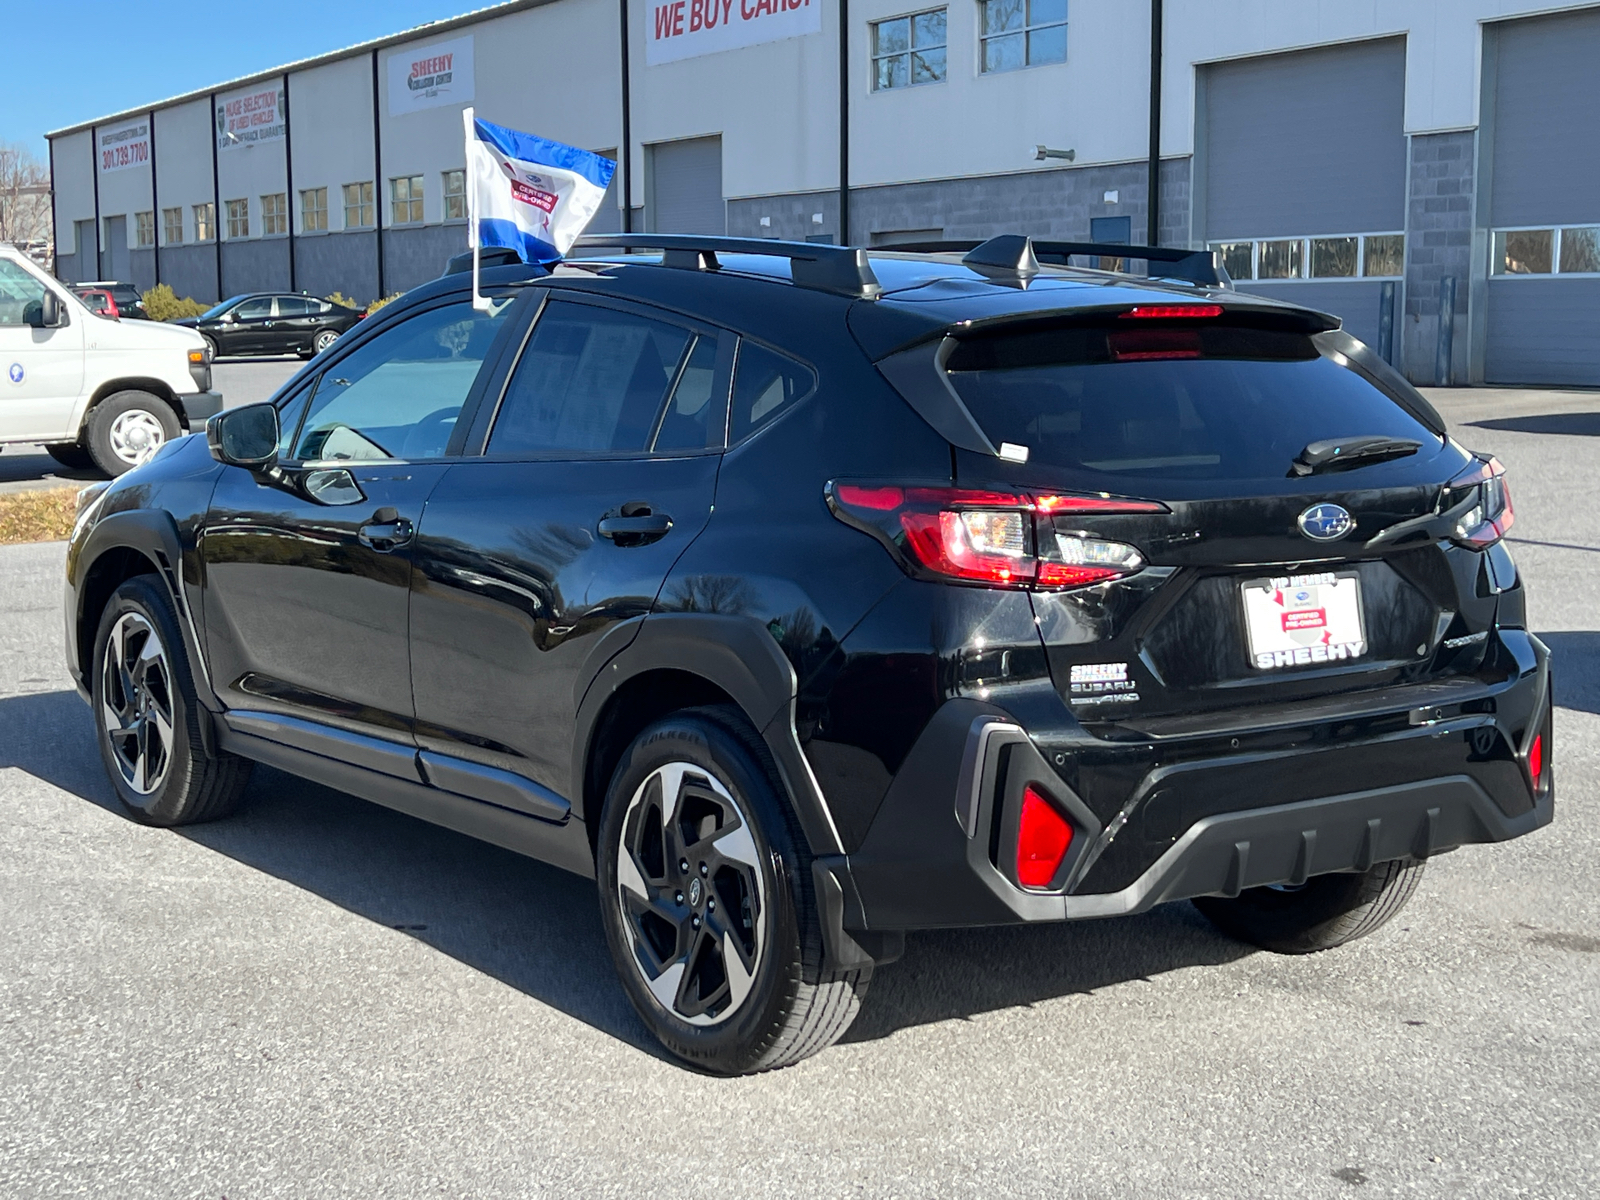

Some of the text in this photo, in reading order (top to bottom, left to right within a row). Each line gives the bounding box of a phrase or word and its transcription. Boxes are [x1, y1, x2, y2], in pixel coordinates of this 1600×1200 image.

[655, 1, 685, 40] WE
[689, 0, 732, 33] BUY
[411, 53, 454, 78] SHEEHY
[226, 91, 276, 117] HUGE SELECTION
[229, 109, 274, 132] OF USED VEHICLES
[102, 141, 149, 170] 301.739.7700
[1269, 572, 1336, 588] VIP MEMBER
[1285, 618, 1323, 628] PRE-OWNED
[1287, 611, 1320, 621] CERTIFIED
[1256, 641, 1364, 669] SHEEHY
[1070, 663, 1128, 676] SHEEHY
[1070, 680, 1136, 692] SUBARU
